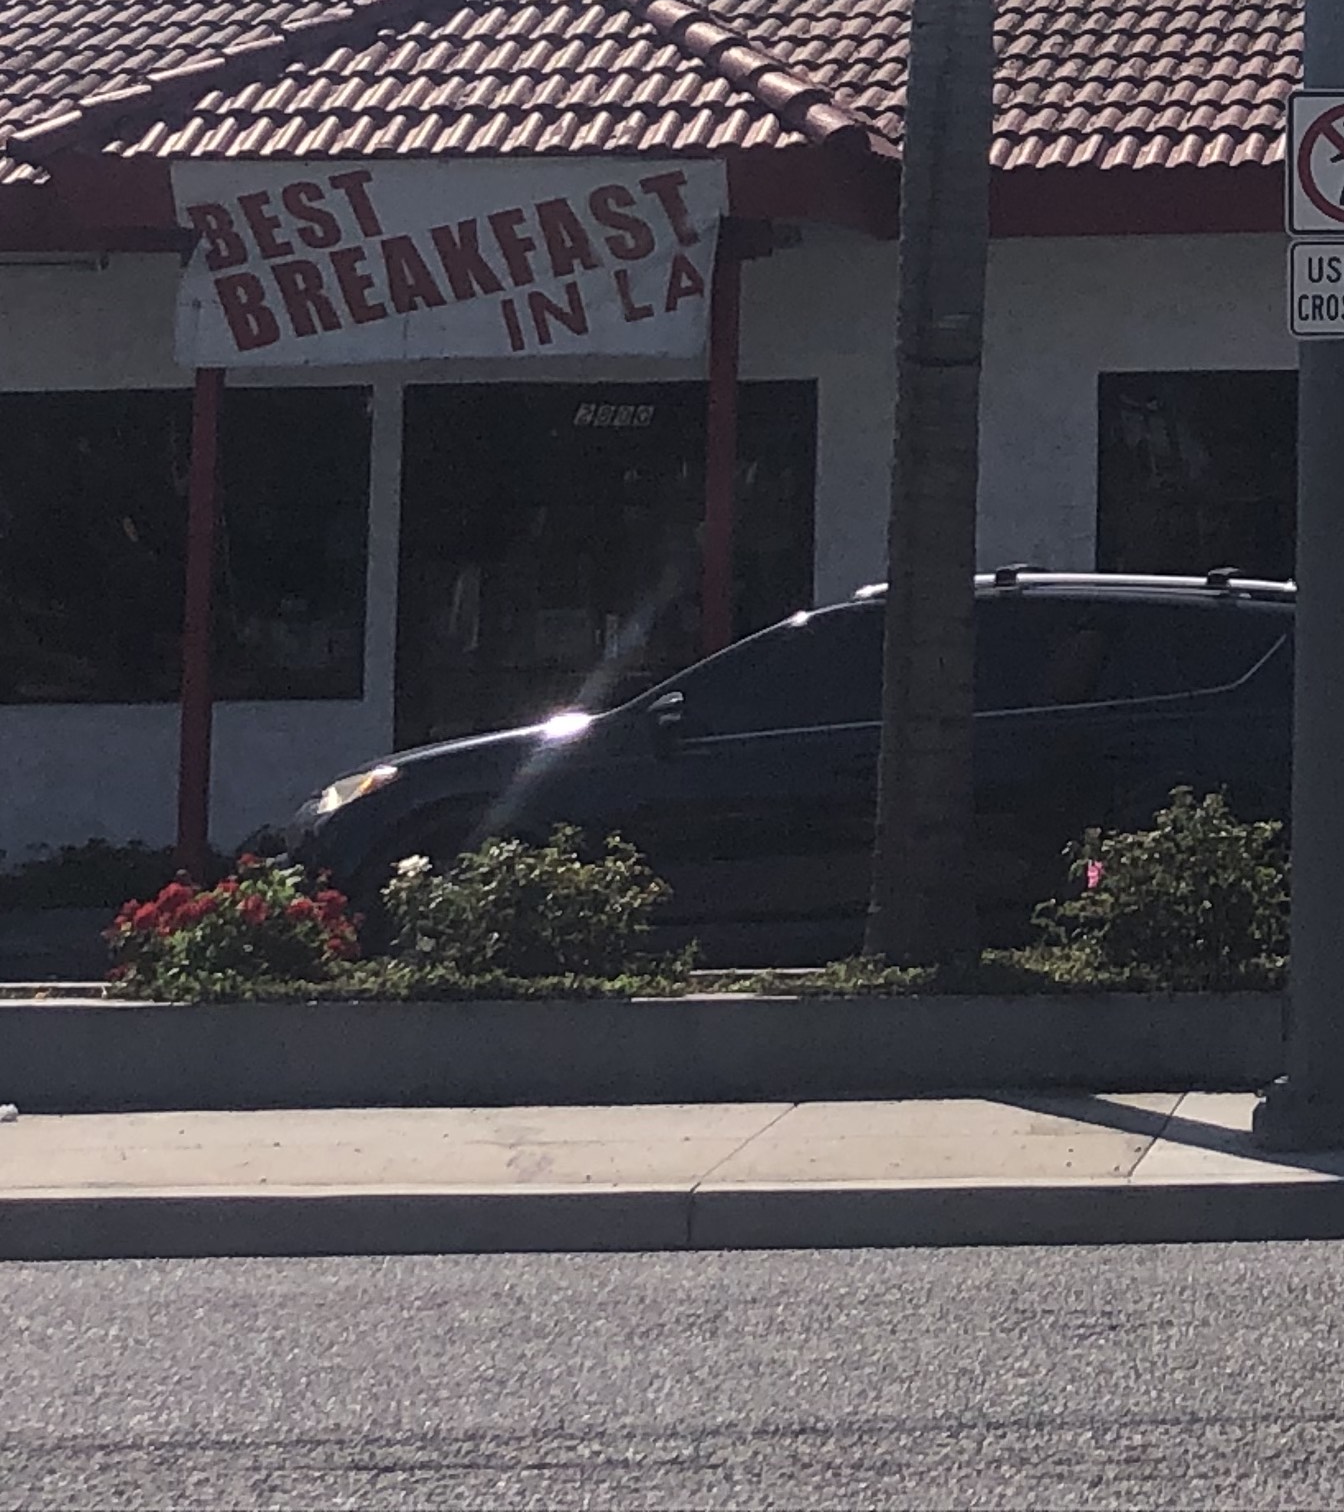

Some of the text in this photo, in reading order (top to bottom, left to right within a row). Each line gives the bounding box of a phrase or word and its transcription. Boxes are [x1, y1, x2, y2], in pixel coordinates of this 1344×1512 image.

[186, 169, 385, 272] BEST
[214, 170, 701, 353] BREAKFAST
[501, 253, 705, 353] IN LA
